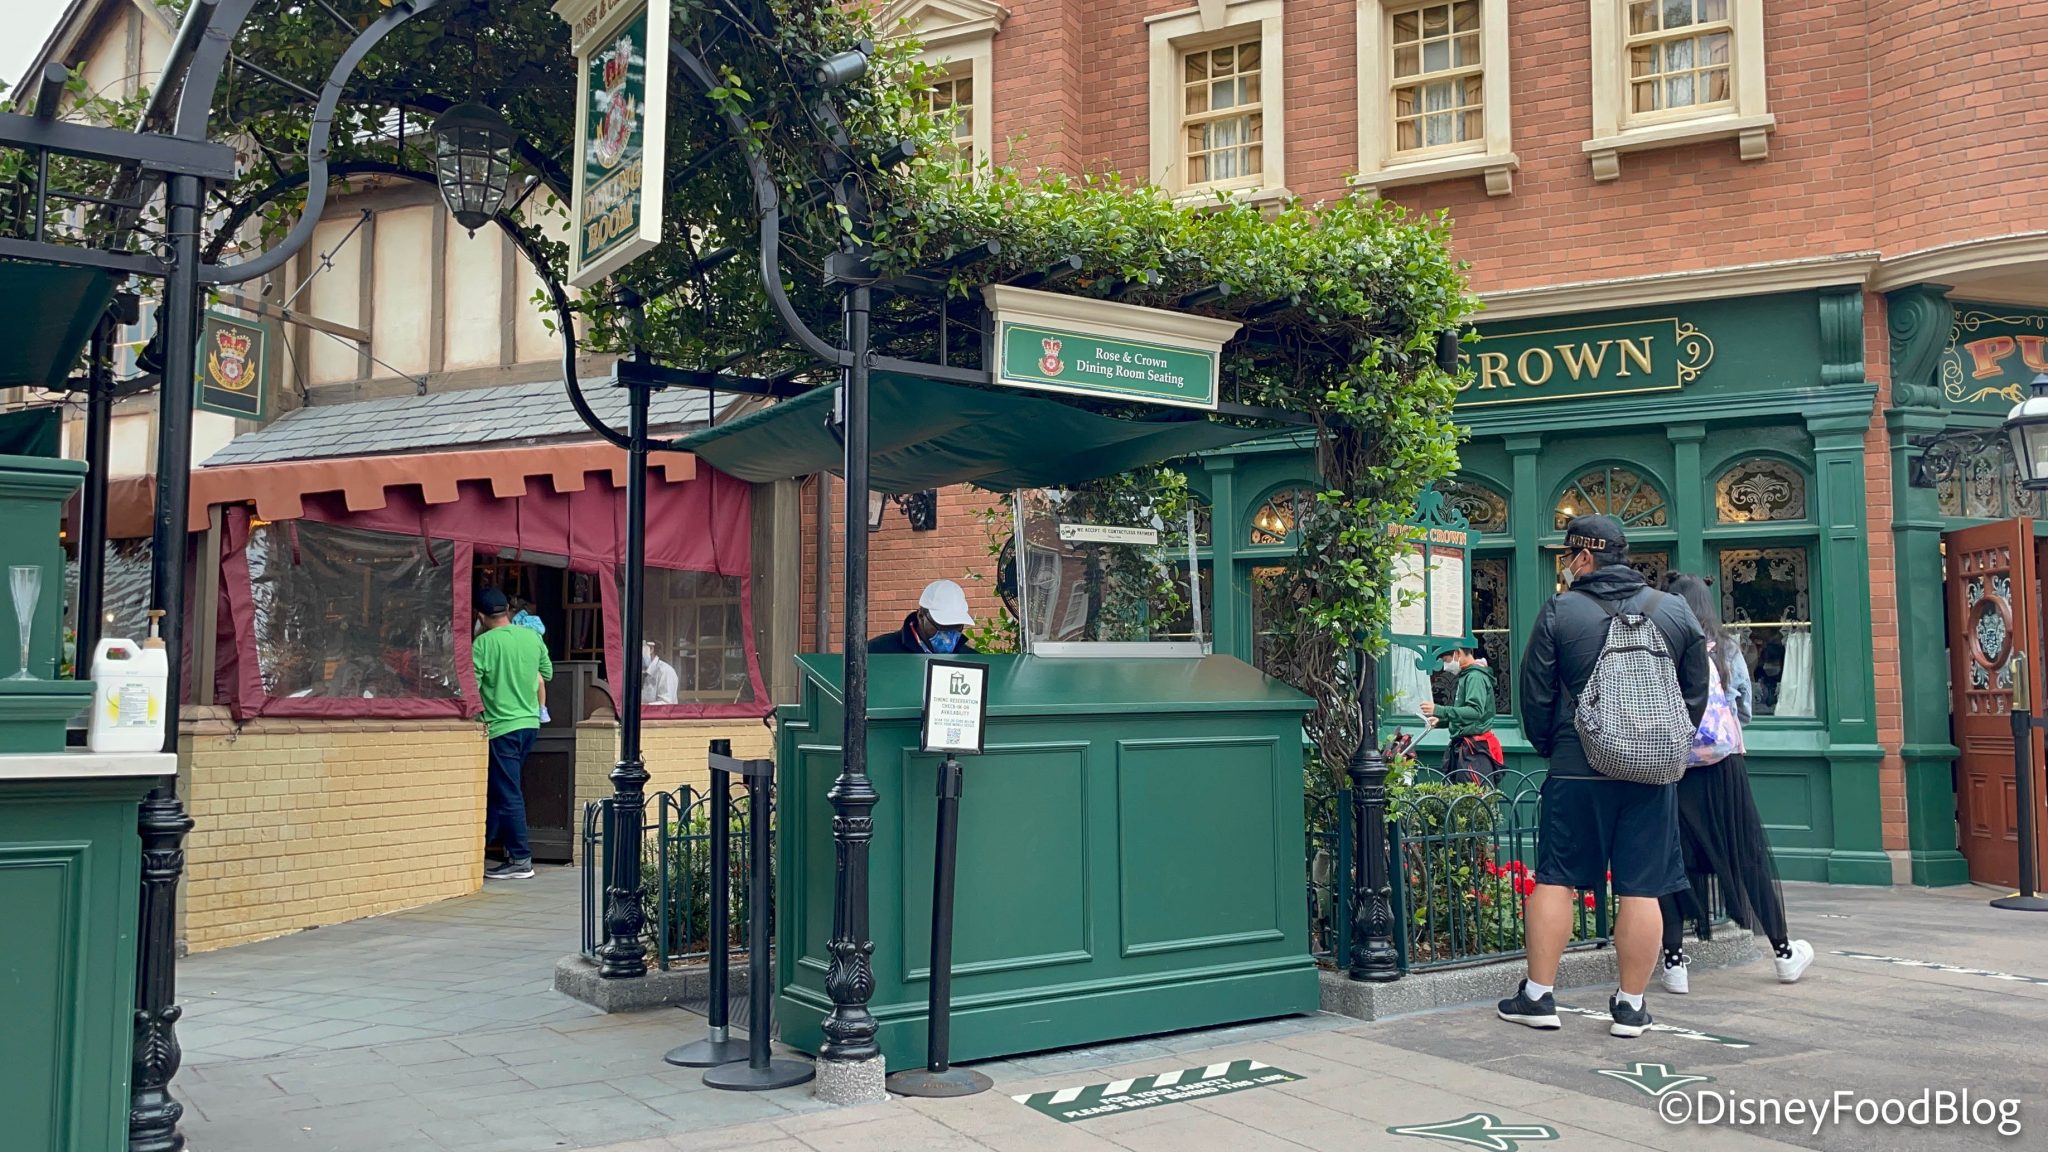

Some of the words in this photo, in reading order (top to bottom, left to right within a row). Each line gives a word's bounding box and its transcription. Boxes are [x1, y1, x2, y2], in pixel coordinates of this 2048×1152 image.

[587, 198, 634, 254] ROOM
[1095, 347, 1121, 363] Rose
[1122, 351, 1132, 364] &
[1134, 353, 1168, 369] Crown
[1686, 341, 1701, 364] 9
[1076, 359, 1114, 378] Dining
[1115, 365, 1145, 380] Room
[1147, 369, 1185, 388] Seating
[1429, 528, 1467, 546] CROWN
[1569, 534, 1607, 550] WORLD
[1062, 1103, 1123, 1119] PLEASE
[1120, 1096, 1163, 1107] WAIT
[1163, 1087, 1219, 1100] BEHIND
[1217, 1080, 1255, 1090] THIS
[1098, 1095, 1135, 1105] FOR
[1131, 1088, 1178, 1098] YOUR
[1175, 1077, 1231, 1091] SAFETY
